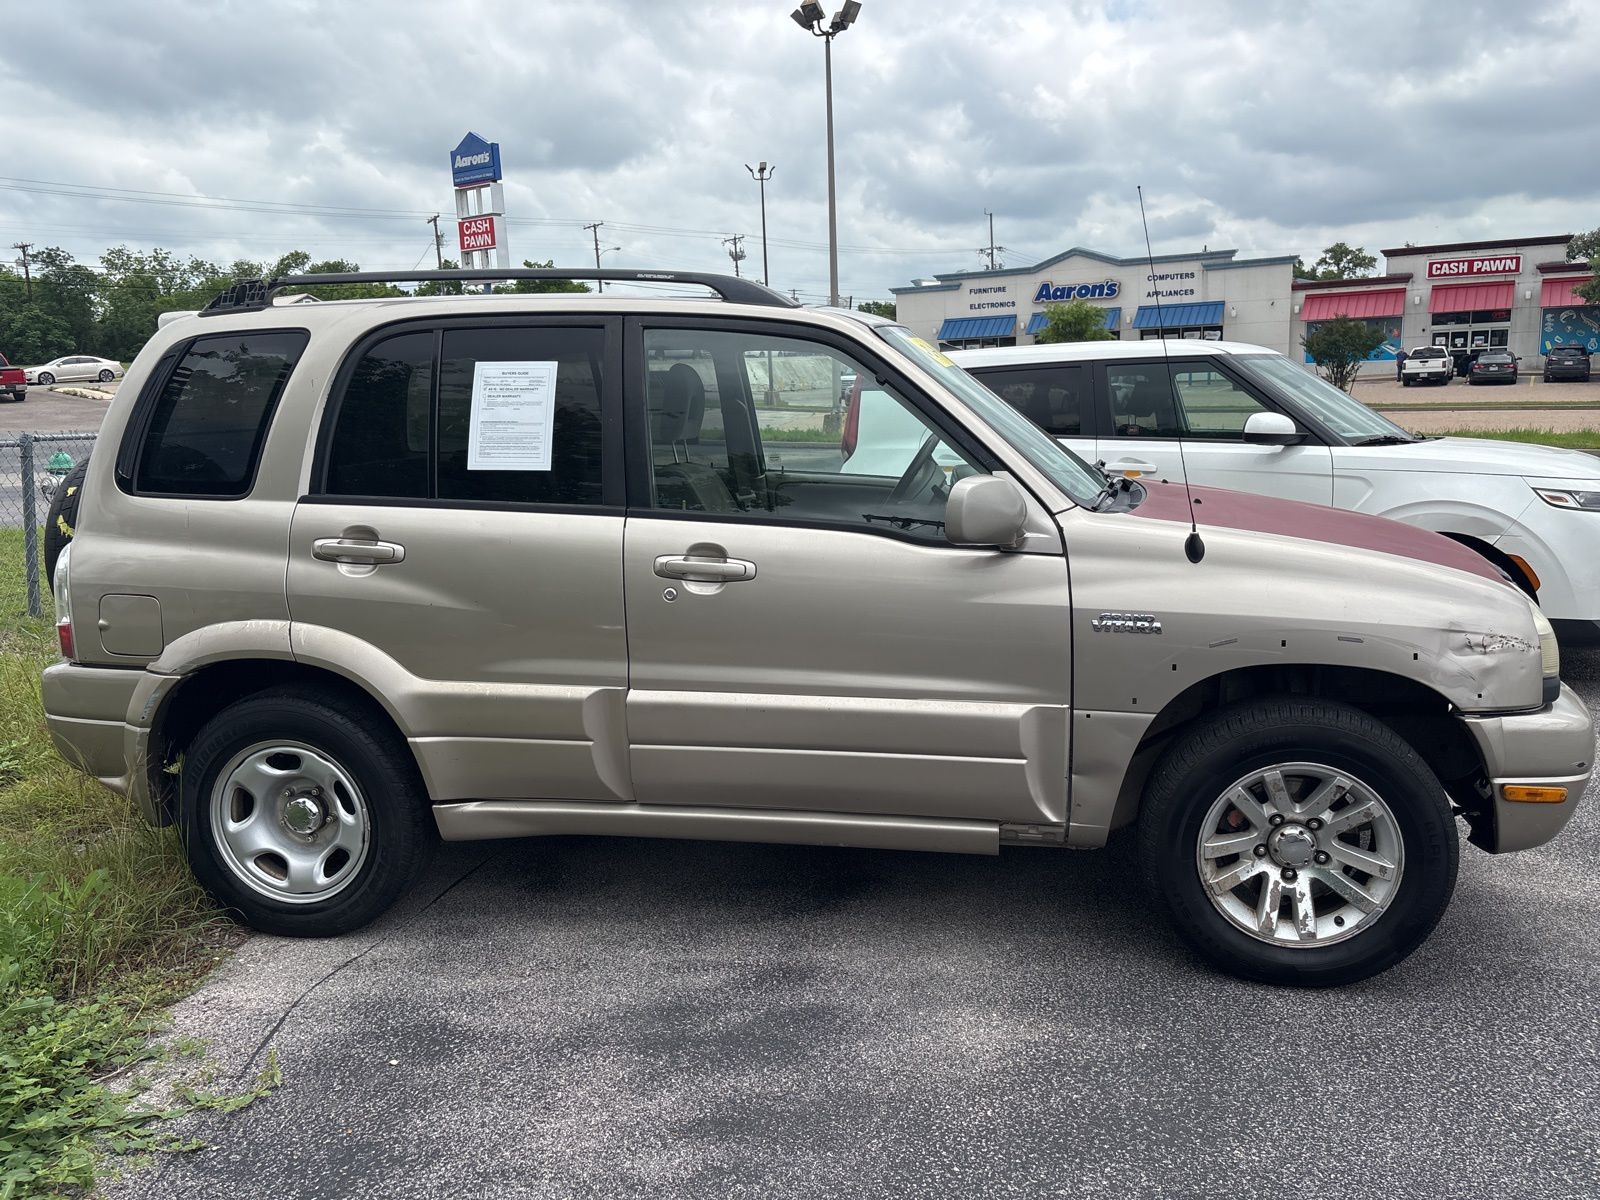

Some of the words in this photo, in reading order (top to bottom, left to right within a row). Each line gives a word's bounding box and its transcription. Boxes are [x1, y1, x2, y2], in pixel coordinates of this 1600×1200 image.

[455, 152, 490, 168] Aaron's
[463, 220, 490, 235] CASH
[464, 233, 492, 249] PAWN
[1432, 260, 1468, 275] CASH
[1473, 258, 1516, 273] PAWN
[1147, 272, 1195, 282] COMPUTERS
[969, 286, 1007, 295] FURNITURE
[1033, 279, 1120, 302] Aaron's
[1146, 288, 1194, 298] APPLIANCES
[969, 301, 1016, 310] ELECTRONICS
[1091, 619, 1162, 634] VITARA
